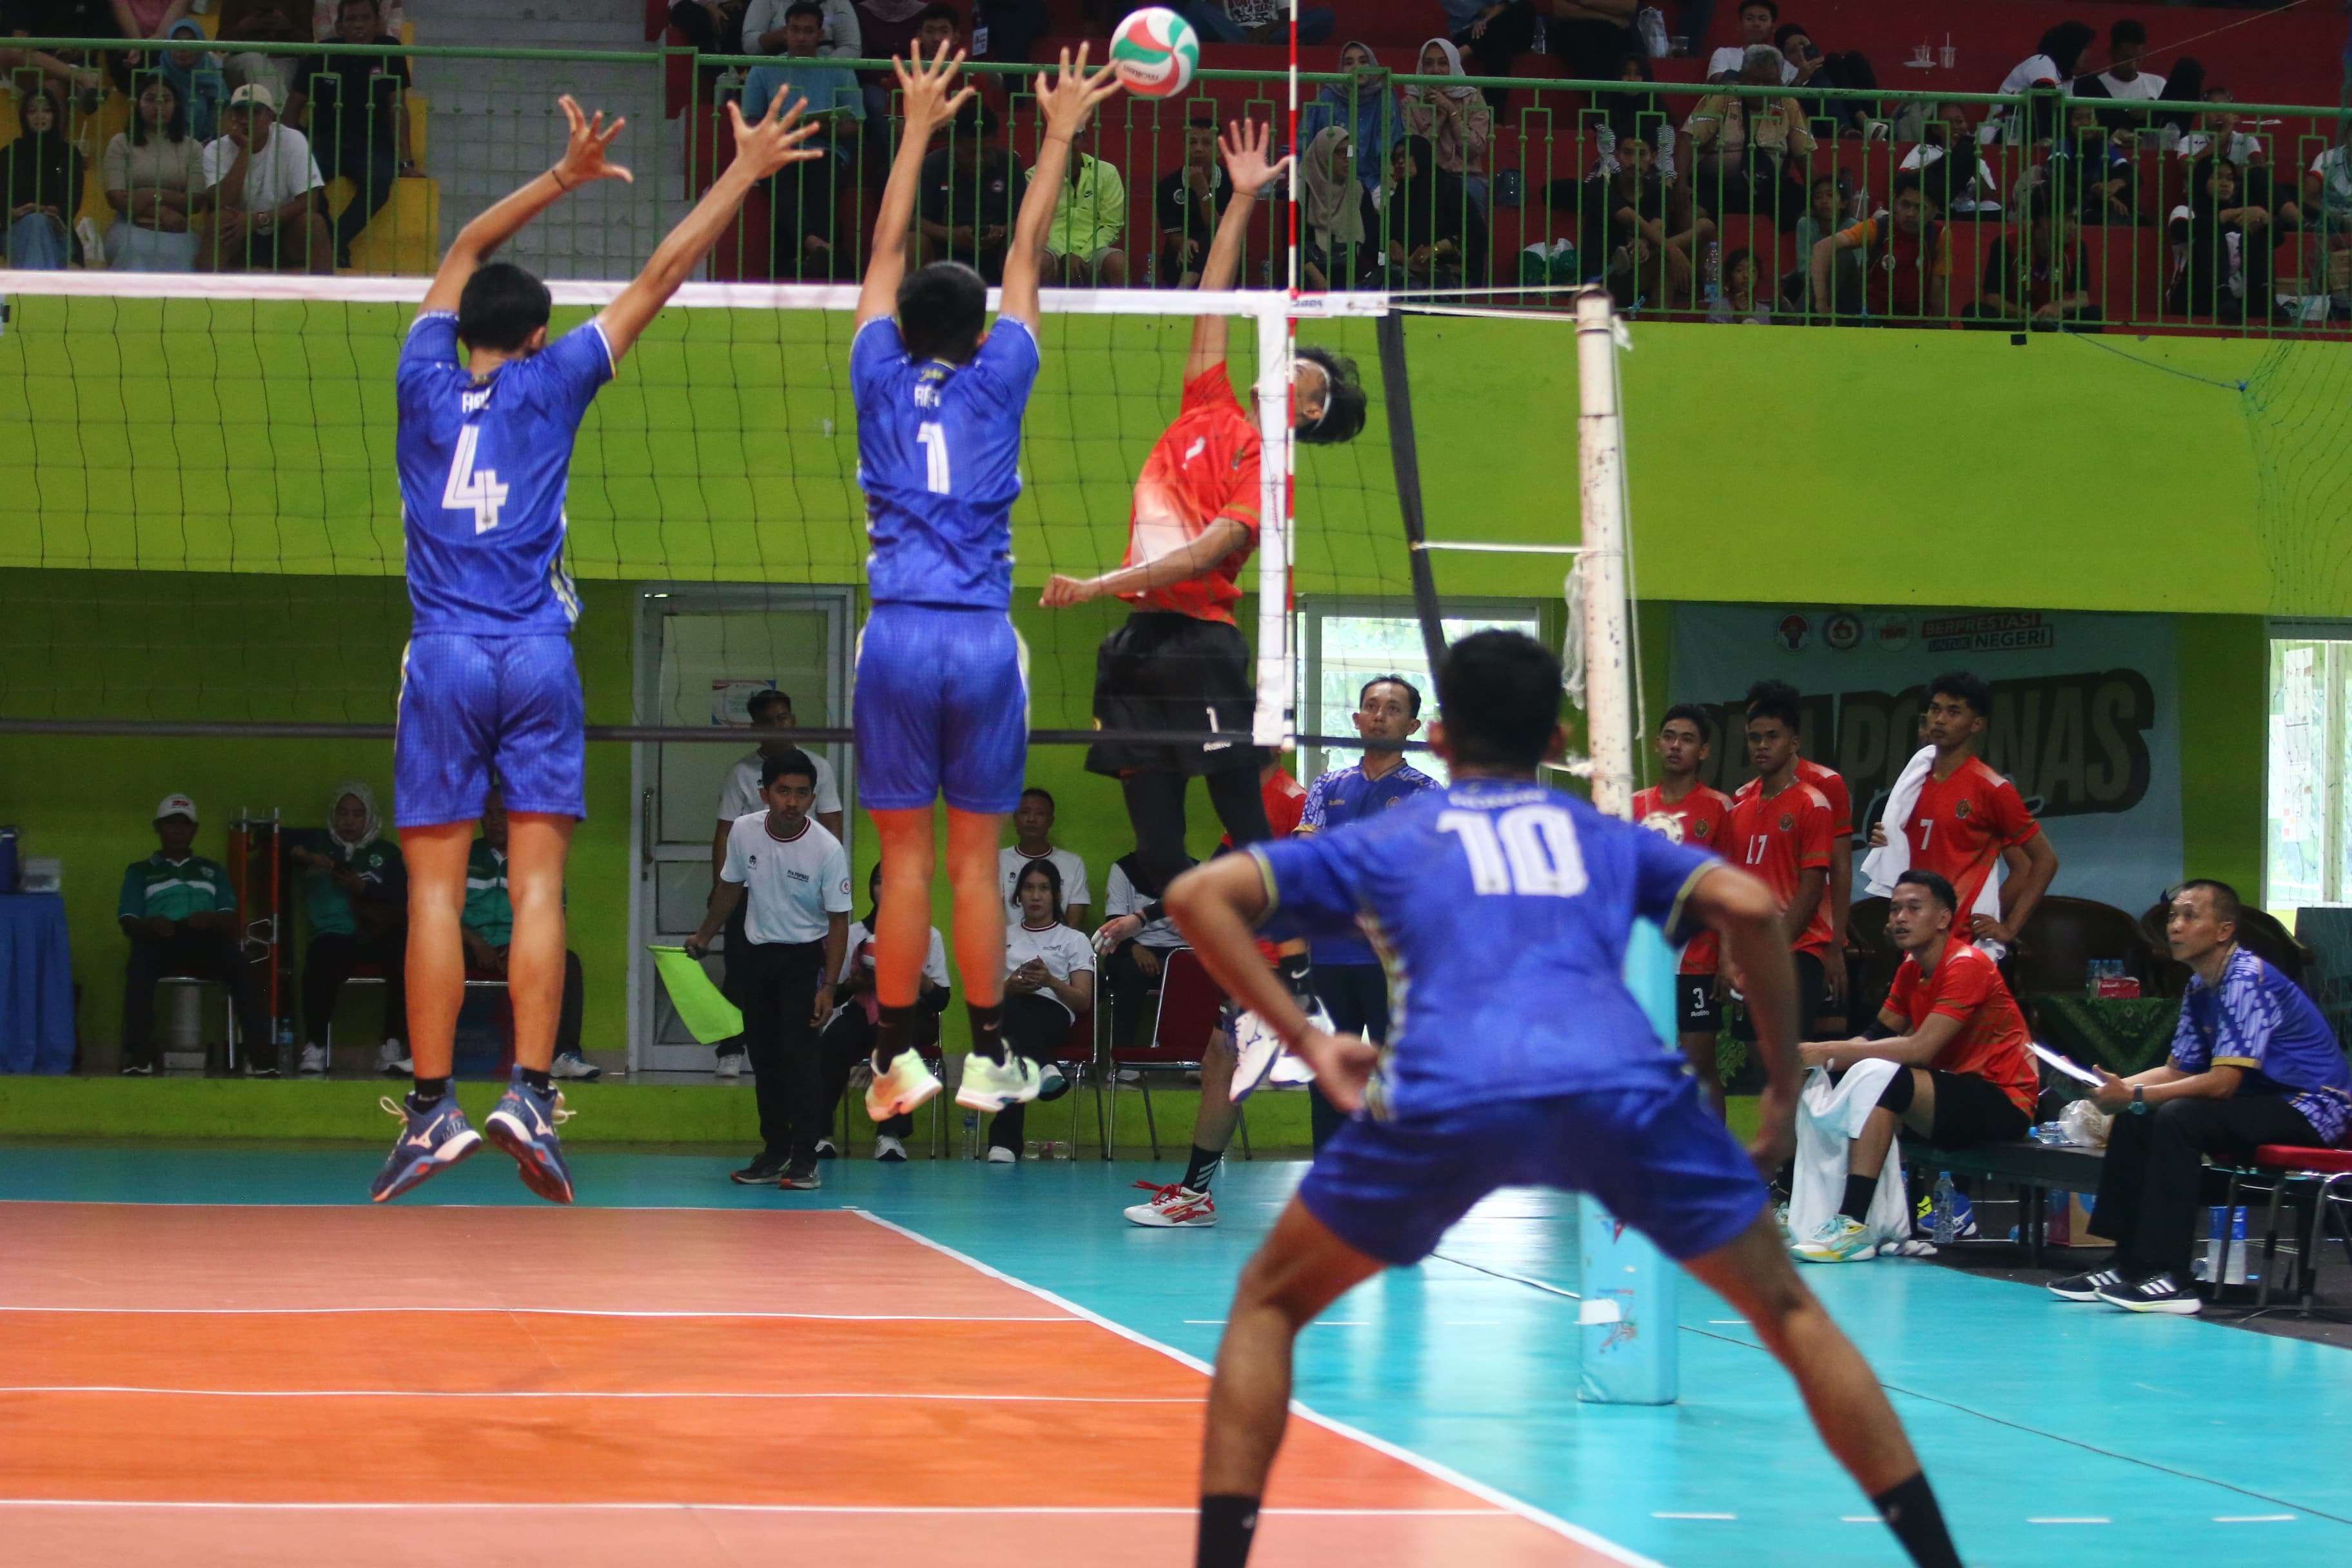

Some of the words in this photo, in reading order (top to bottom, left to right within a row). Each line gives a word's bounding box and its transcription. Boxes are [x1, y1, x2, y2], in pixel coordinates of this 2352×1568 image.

[916, 422, 950, 495] 1
[442, 424, 509, 536] 4
[1926, 614, 2039, 636] BERPRESTASI
[1975, 630, 2046, 647] NEGERI
[1206, 707, 1219, 734] 1
[1745, 834, 1768, 865] 17
[1920, 818, 1934, 850] 7
[1436, 803, 1588, 898] 10
[1692, 987, 1705, 1009] 3
